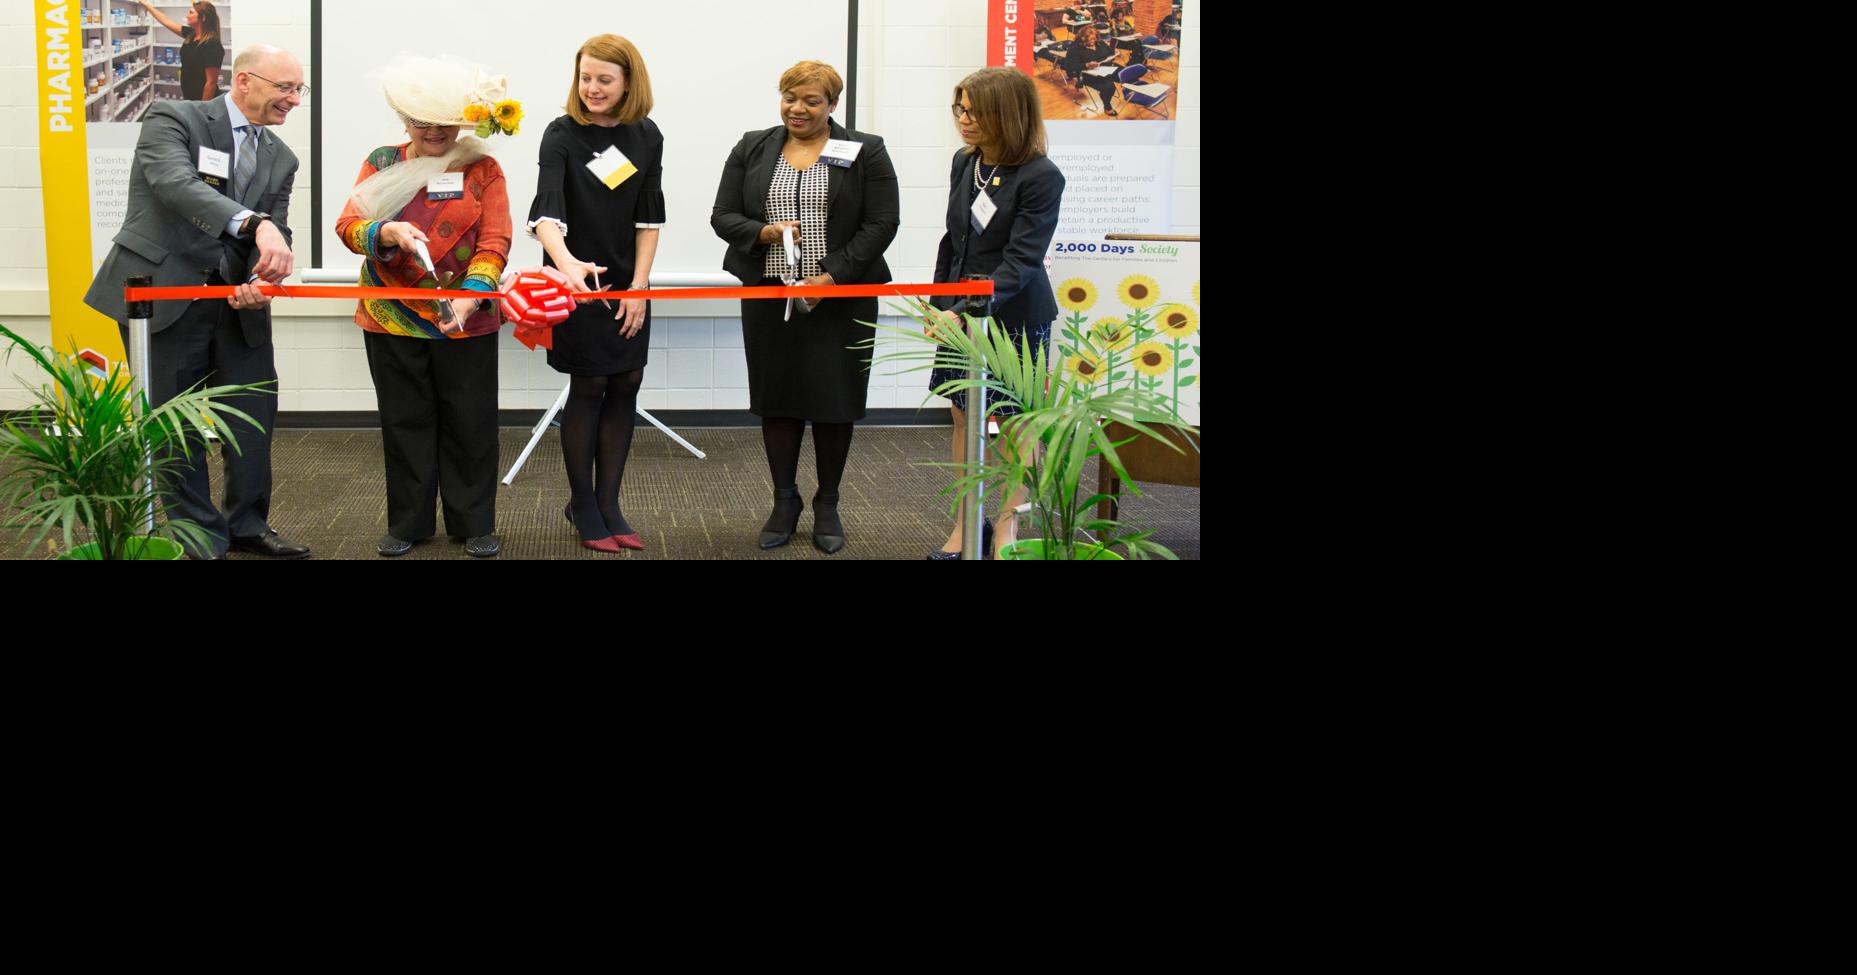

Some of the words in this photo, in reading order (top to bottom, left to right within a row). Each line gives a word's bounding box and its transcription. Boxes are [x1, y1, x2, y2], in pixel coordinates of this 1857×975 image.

[45, 0, 74, 132] PHARMA
[94, 156, 127, 165] Clients
[1110, 175, 1154, 183] prepared
[1075, 185, 1108, 193] placed
[97, 210, 126, 218] comp
[1060, 206, 1108, 214] mployers
[1097, 217, 1150, 225] productive
[1055, 243, 1096, 253] 2,000
[1100, 243, 1135, 255] Days
[1139, 244, 1179, 257] Society
